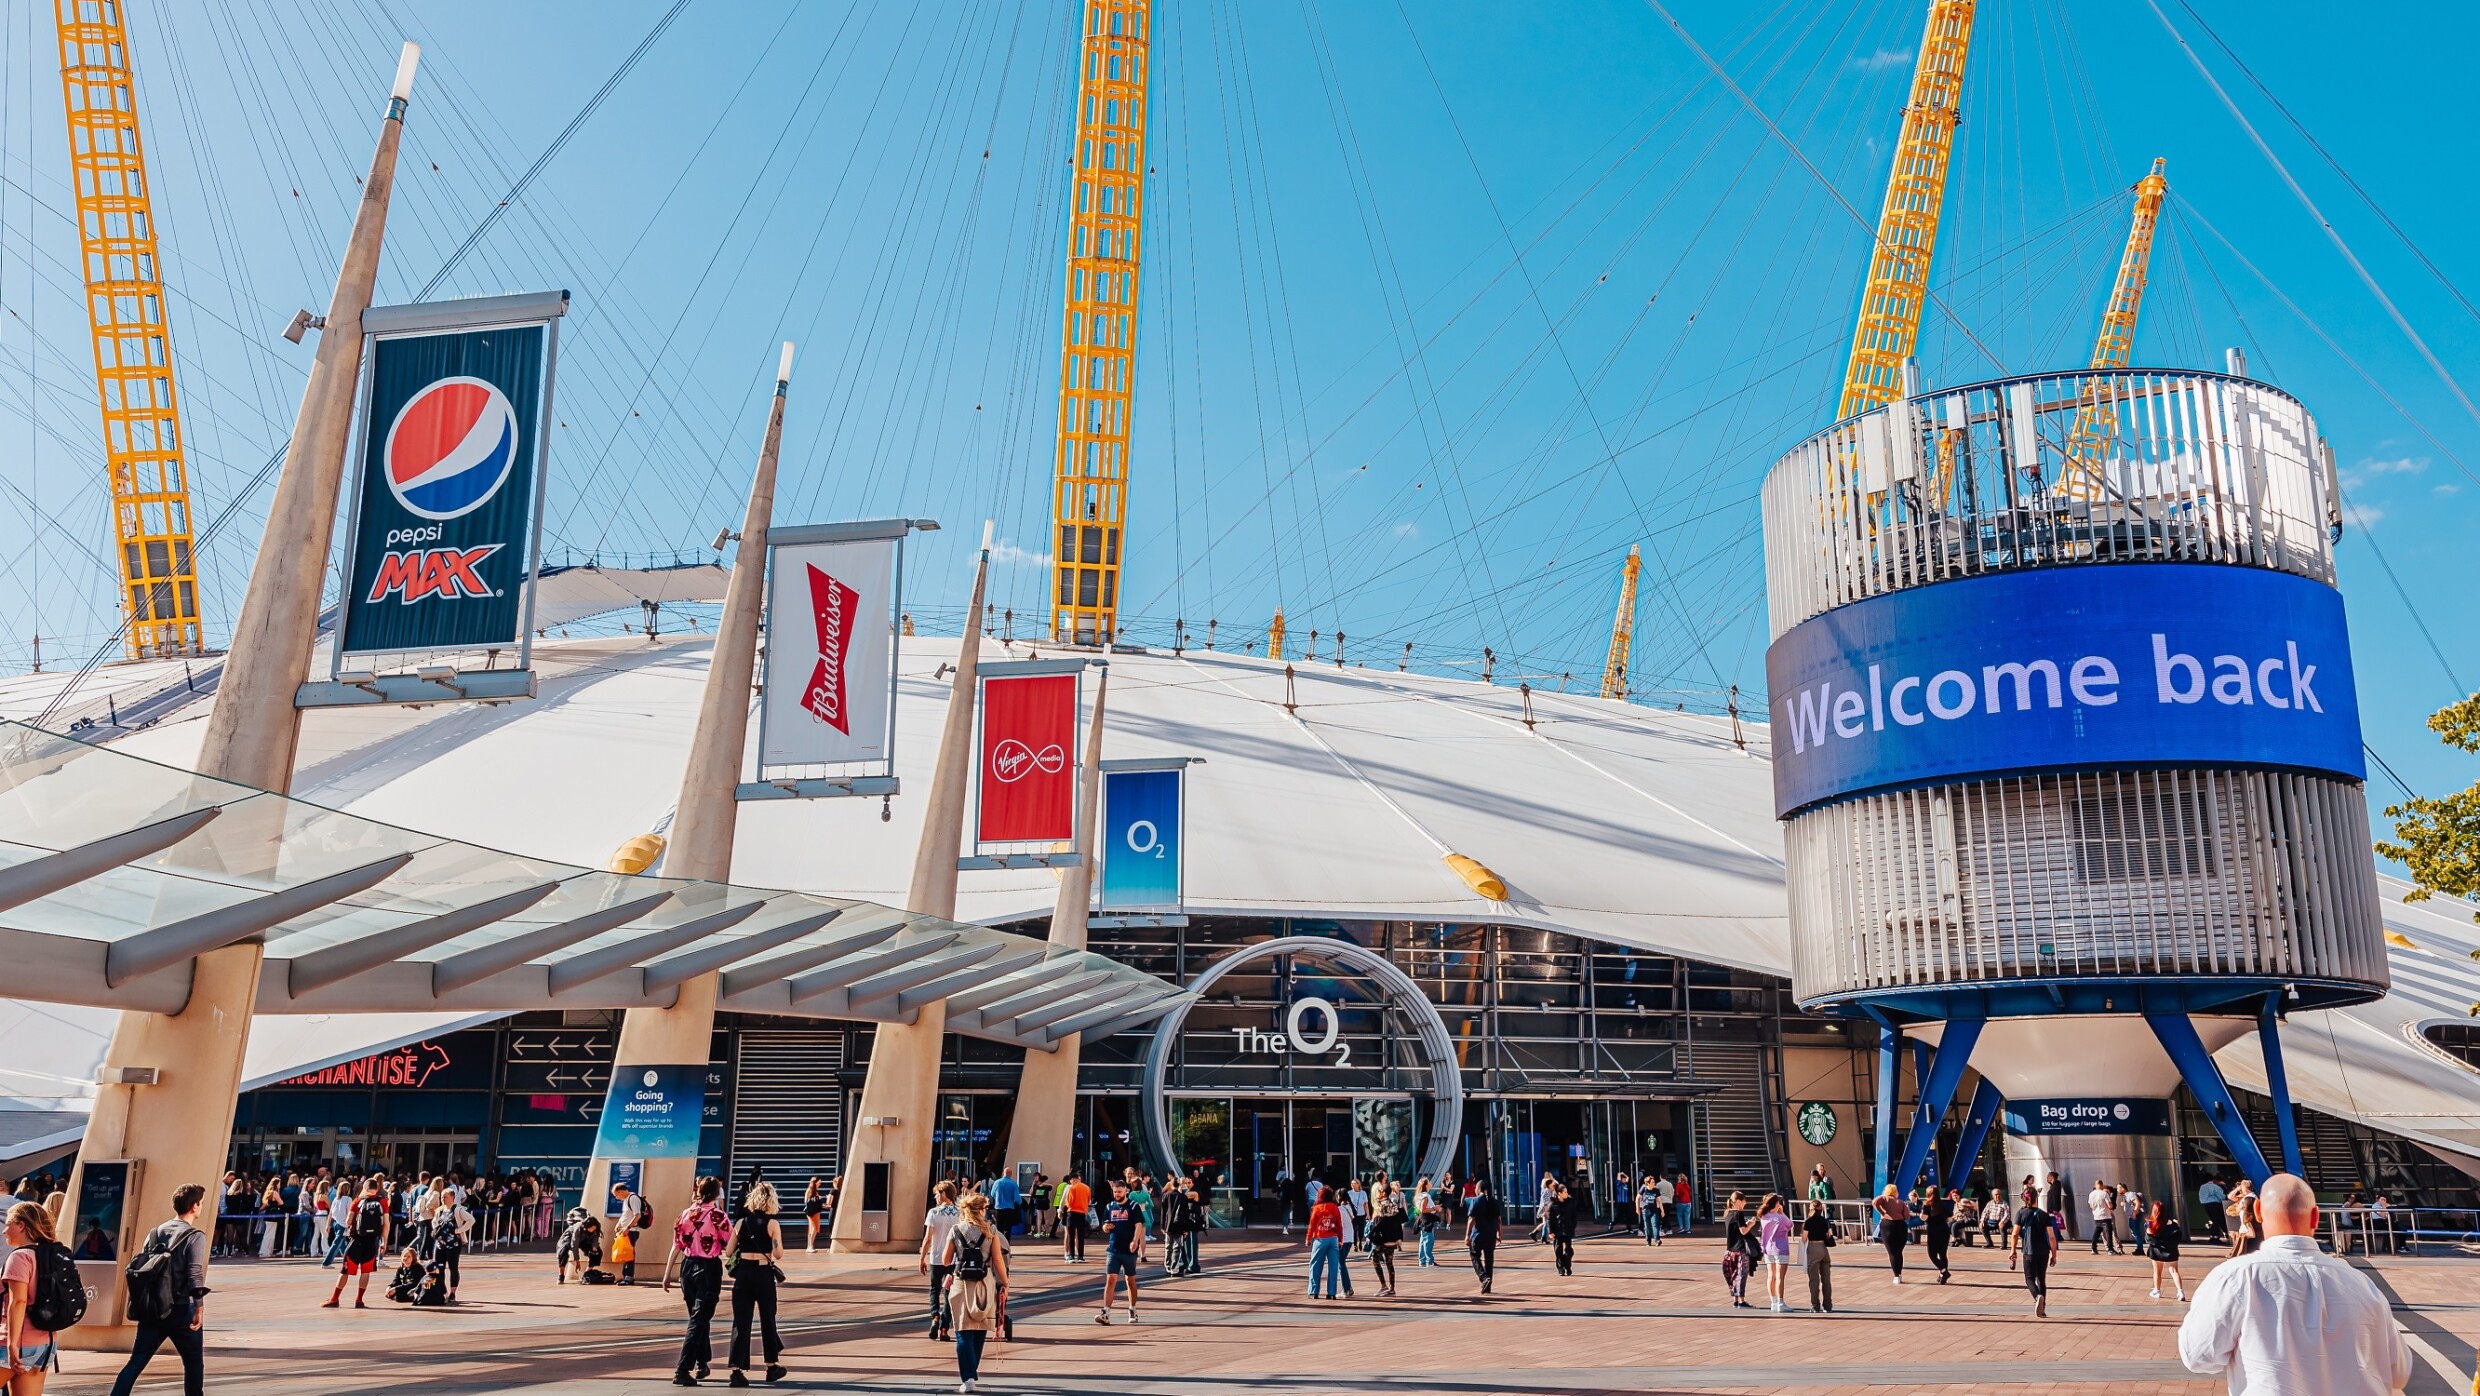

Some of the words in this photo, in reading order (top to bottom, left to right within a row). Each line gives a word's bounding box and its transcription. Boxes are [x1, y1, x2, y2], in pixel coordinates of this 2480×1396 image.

[386, 523, 442, 548] pepsi
[366, 543, 506, 605] MAX
[812, 577, 844, 724] Budweiser
[1785, 653, 2121, 755] Welcome
[2151, 632, 2325, 714] back
[998, 747, 1028, 774] Virgin
[1039, 755, 1062, 763] media
[1126, 820, 1165, 859] O2
[1231, 1026, 1287, 1054] The
[624, 1102, 674, 1113] shopping?
[635, 1090, 664, 1102] Going
[2041, 1104, 2068, 1120] Bag
[2071, 1103, 2109, 1120] drop
